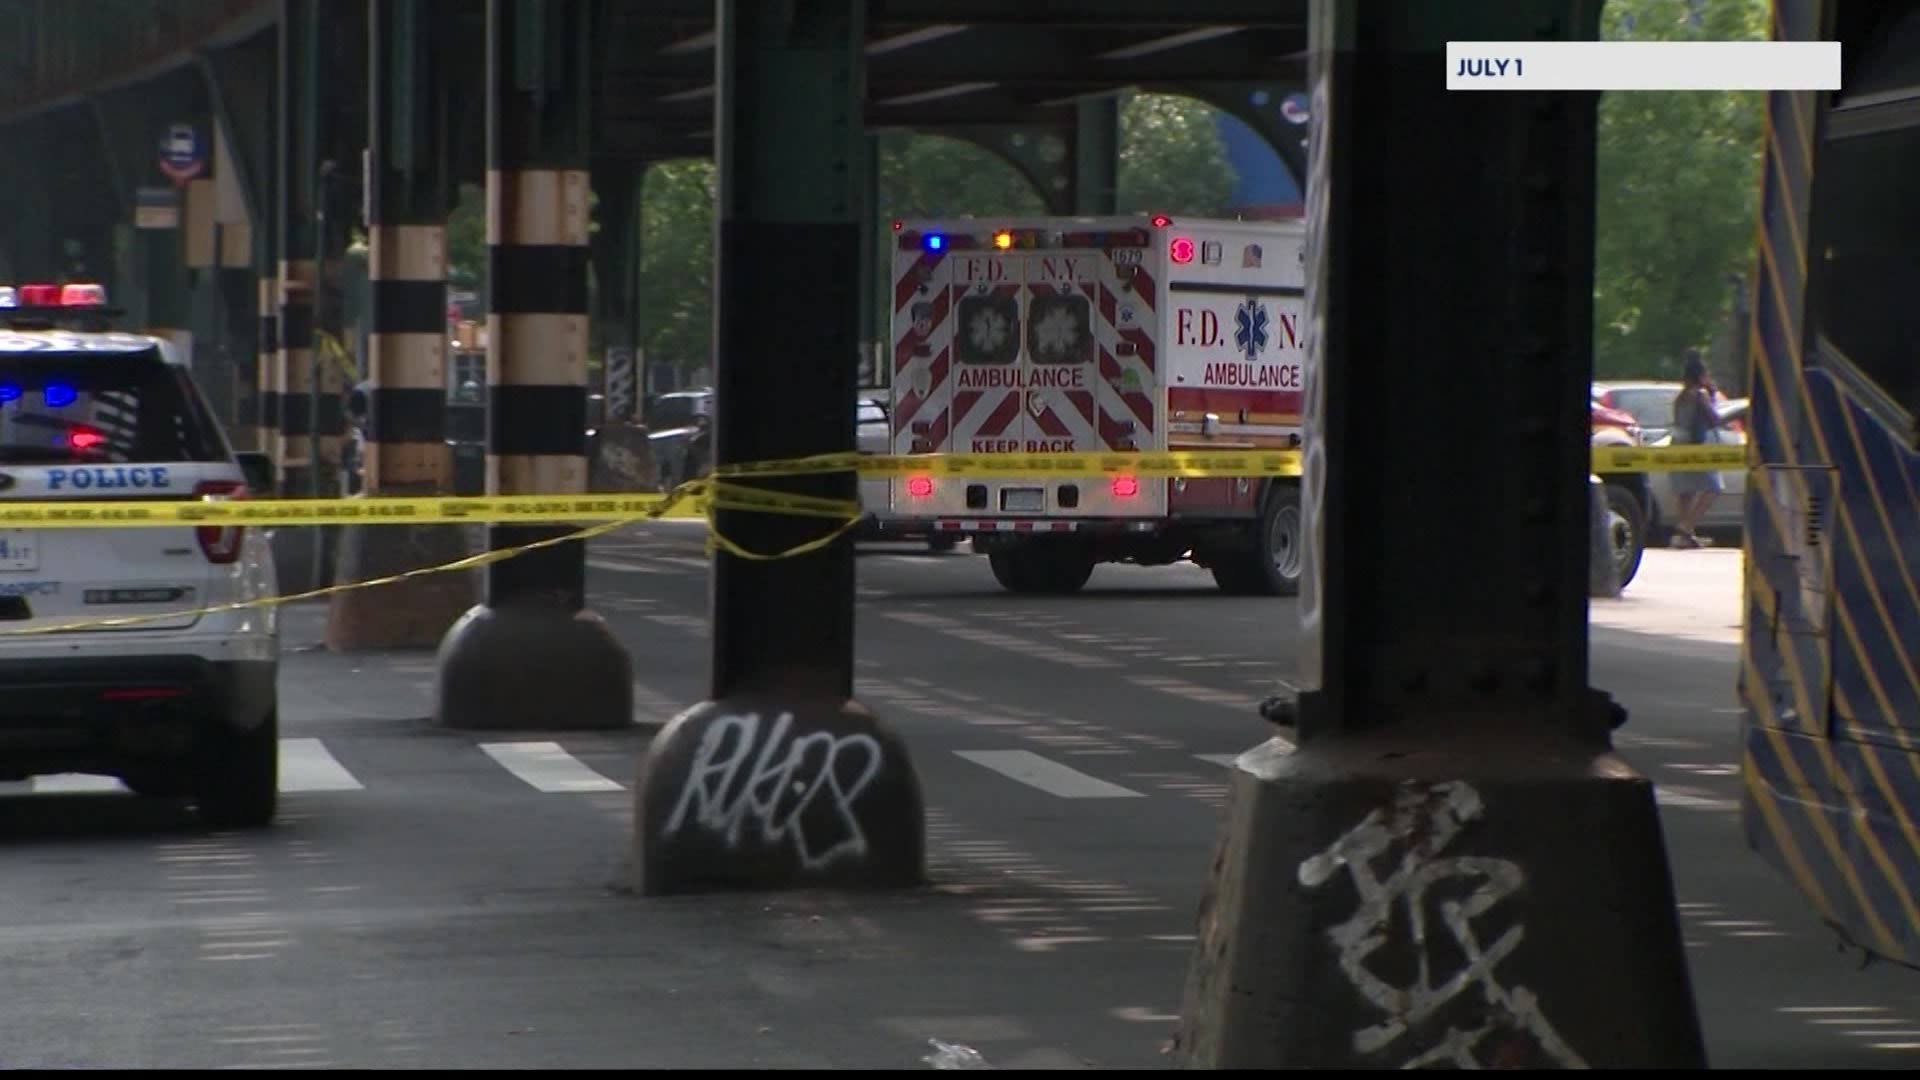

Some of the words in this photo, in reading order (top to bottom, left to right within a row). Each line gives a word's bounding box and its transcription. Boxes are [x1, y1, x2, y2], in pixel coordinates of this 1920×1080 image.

[967, 258, 1008, 281] F.D.
[1041, 257, 1083, 281] N.Y.
[1113, 250, 1143, 265] 1679
[1177, 307, 1224, 348] F.D.
[957, 367, 1084, 388] AMBULANCE
[1203, 362, 1300, 388] AMBULANCE
[972, 439, 1019, 454] KEEP
[1026, 439, 1075, 454] BACK
[47, 467, 171, 490] POLICE
